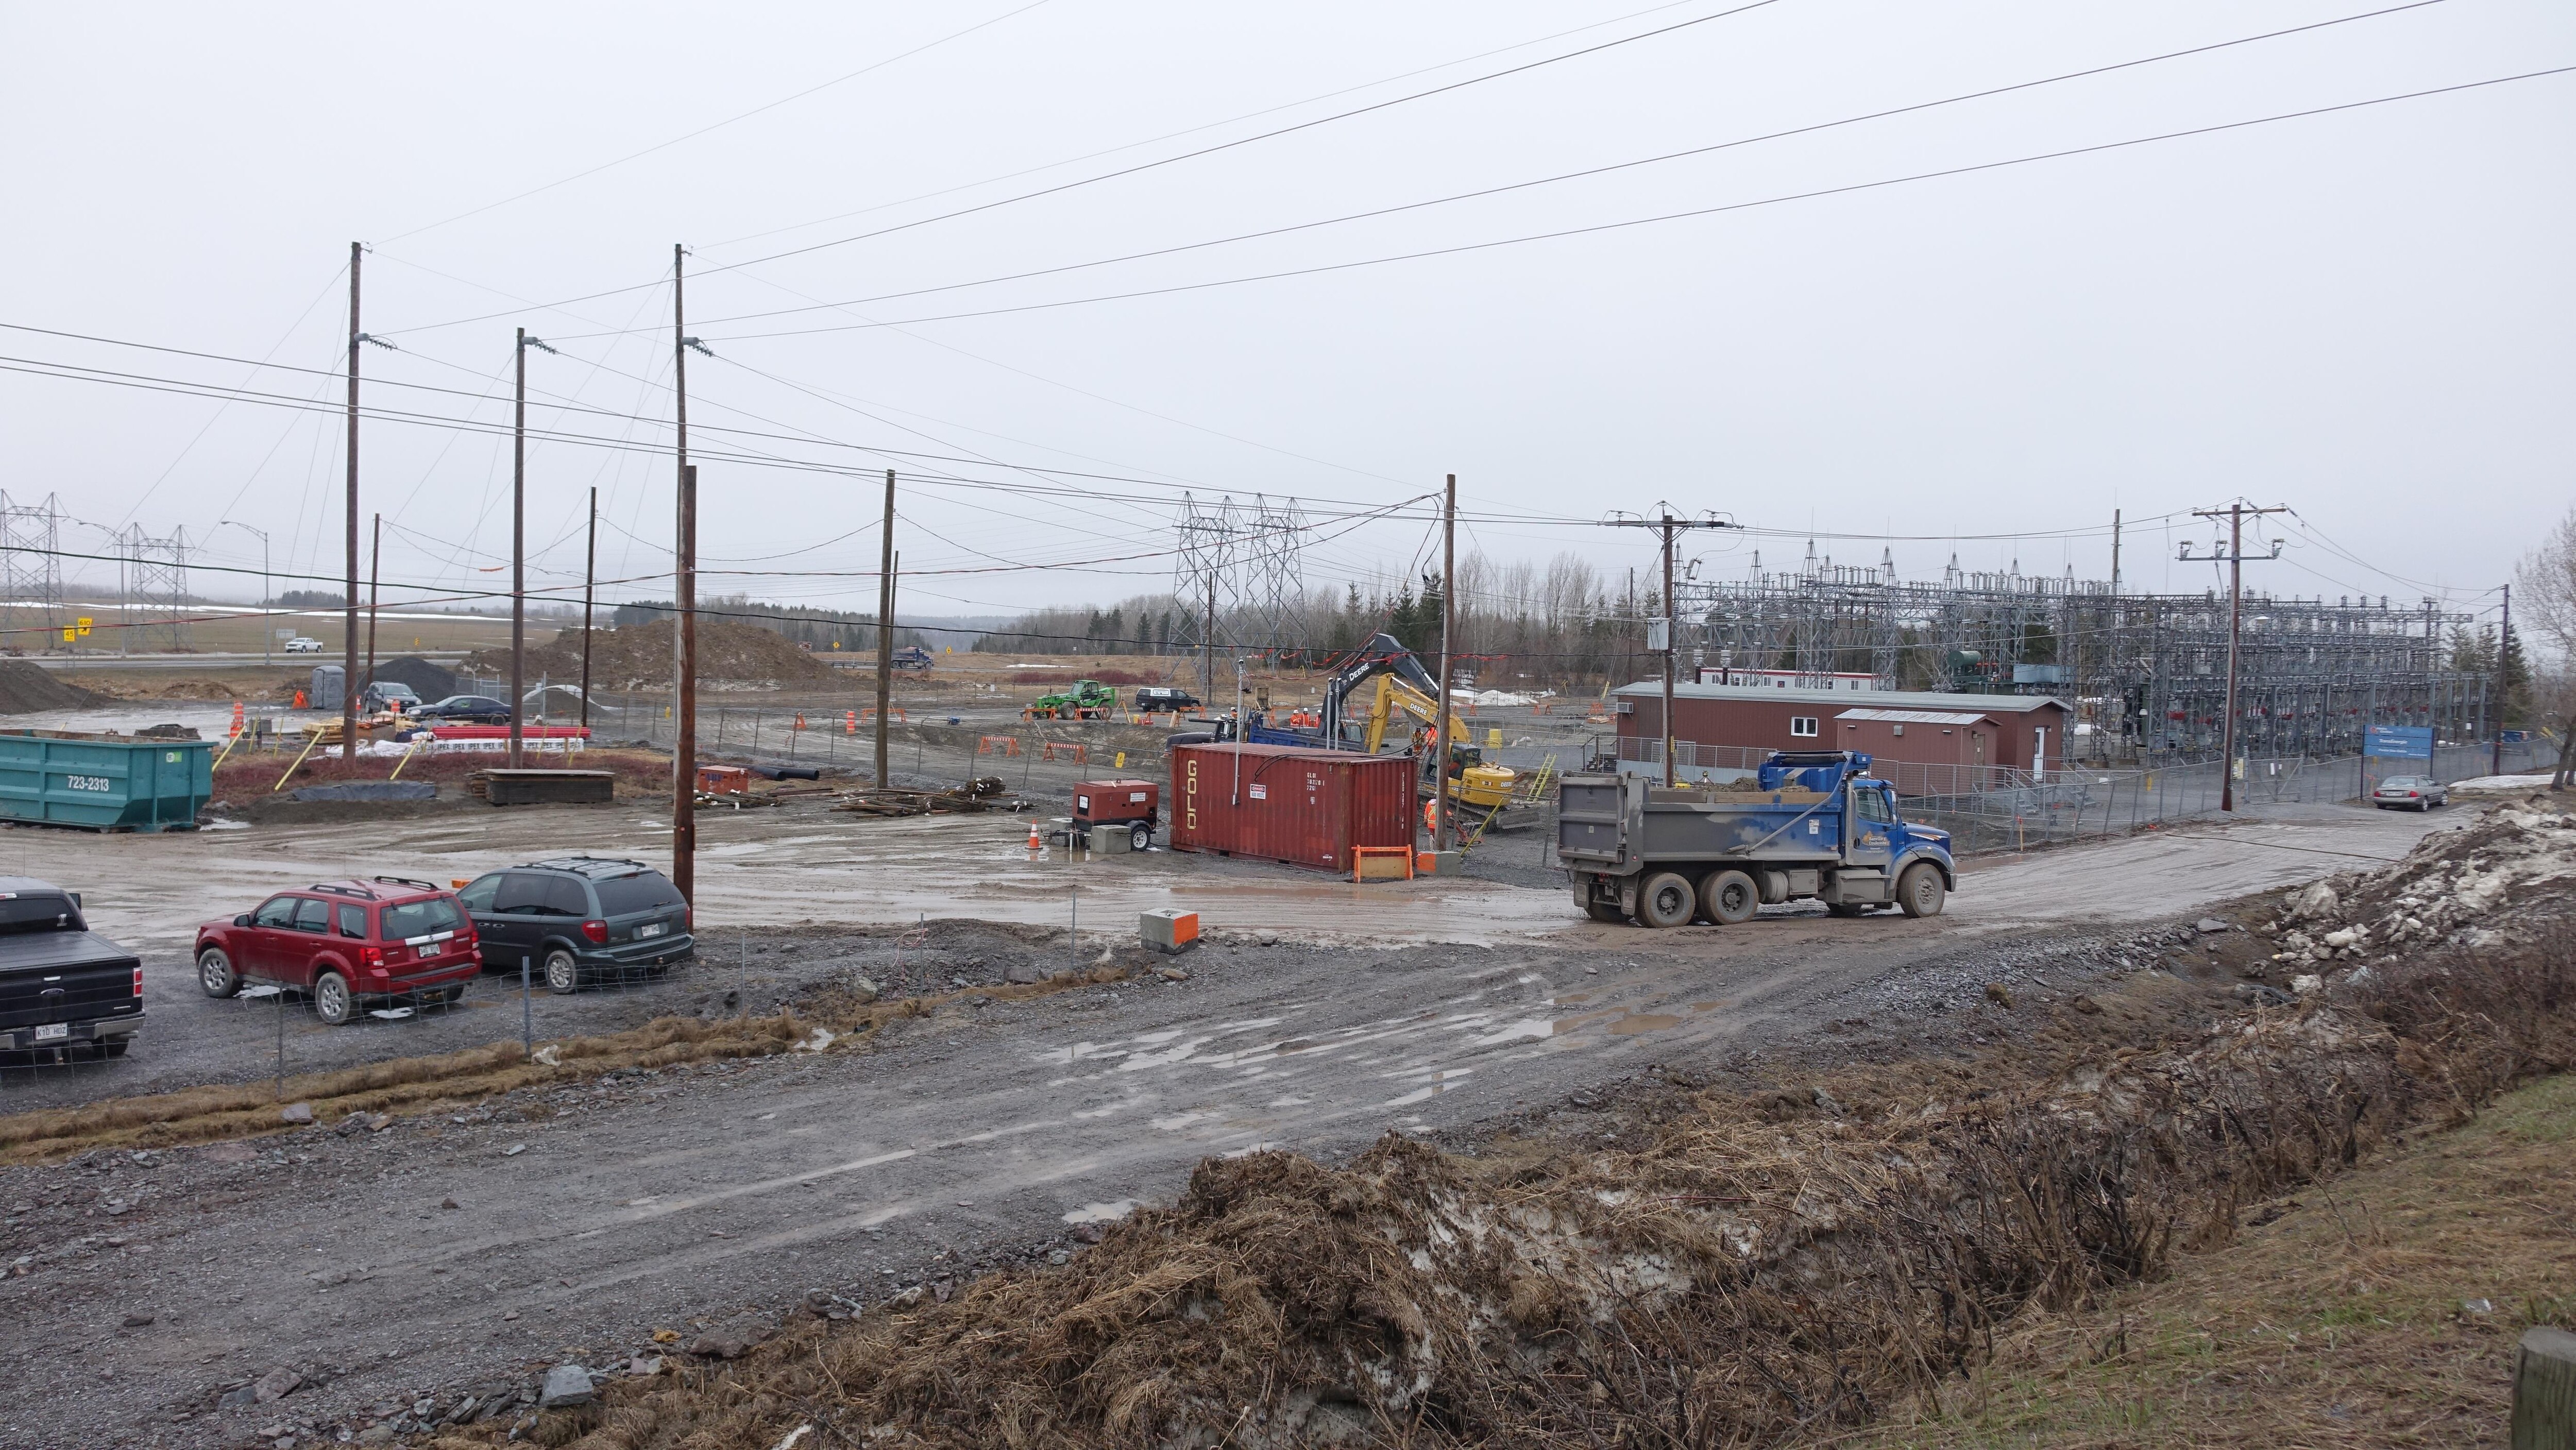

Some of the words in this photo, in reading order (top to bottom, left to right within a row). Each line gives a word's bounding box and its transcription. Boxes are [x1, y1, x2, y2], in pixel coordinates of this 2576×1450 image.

[1349, 662, 1370, 681] DEERE
[1409, 702, 1429, 717] DEERE
[67, 775, 109, 792] 723-2313
[1187, 760, 1197, 829] GOLD
